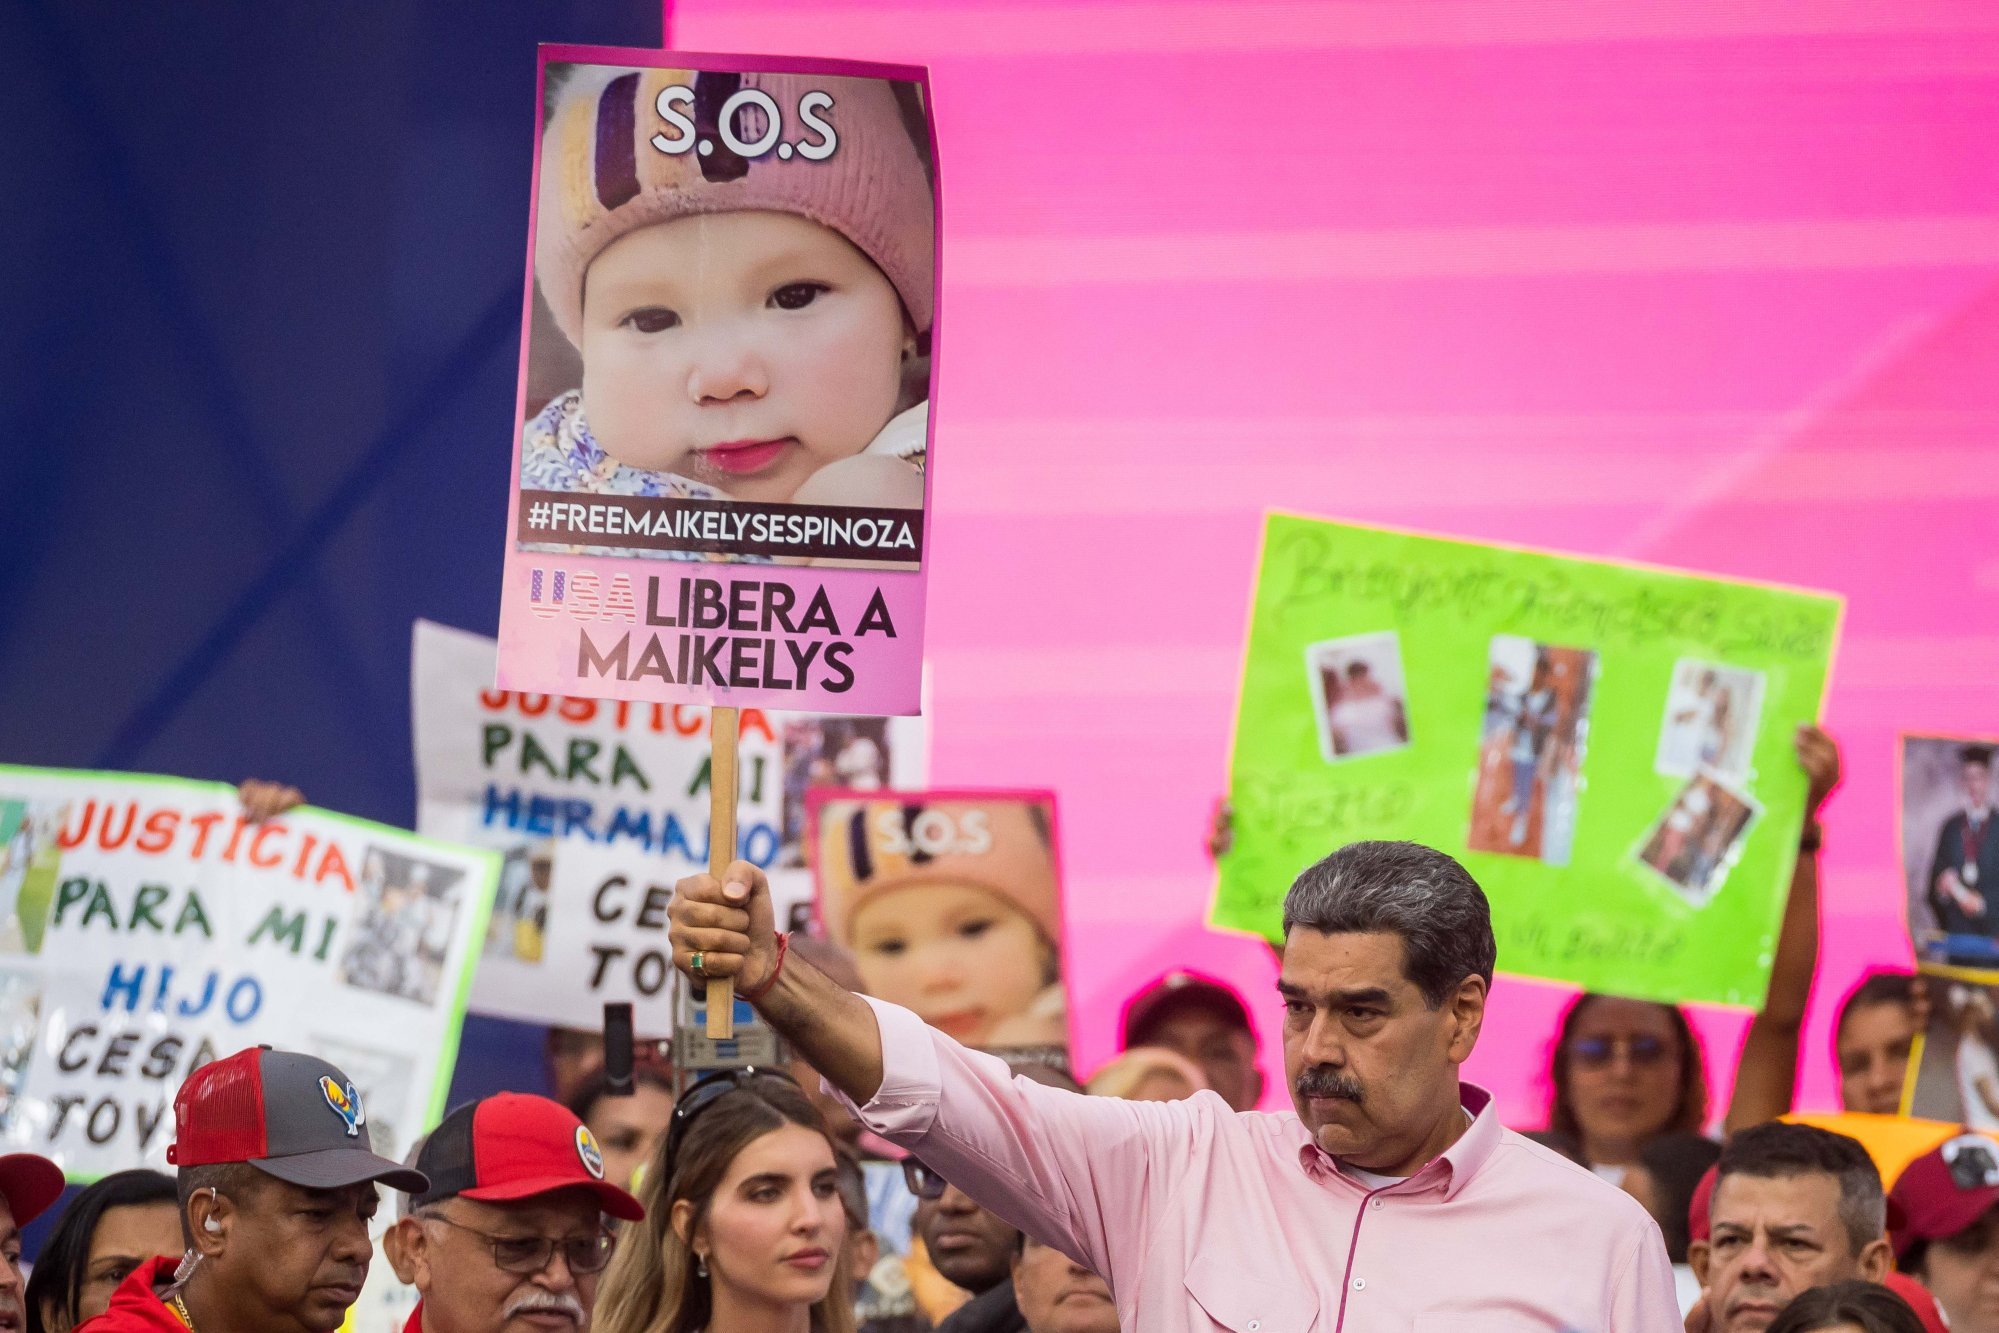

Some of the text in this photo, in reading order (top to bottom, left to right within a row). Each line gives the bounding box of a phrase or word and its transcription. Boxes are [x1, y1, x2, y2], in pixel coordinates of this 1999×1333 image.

[651, 85, 838, 160] S.O.S
[528, 501, 916, 549] #FREEMAIKELYSESPINOZA
[529, 568, 897, 638] USA LIBERA A
[577, 626, 855, 693] MAIKELYS
[481, 722, 651, 793] PARA
[56, 800, 356, 893] JUSTICIA
[53, 876, 338, 961] PARA MI
[102, 960, 262, 1025] HIJO
